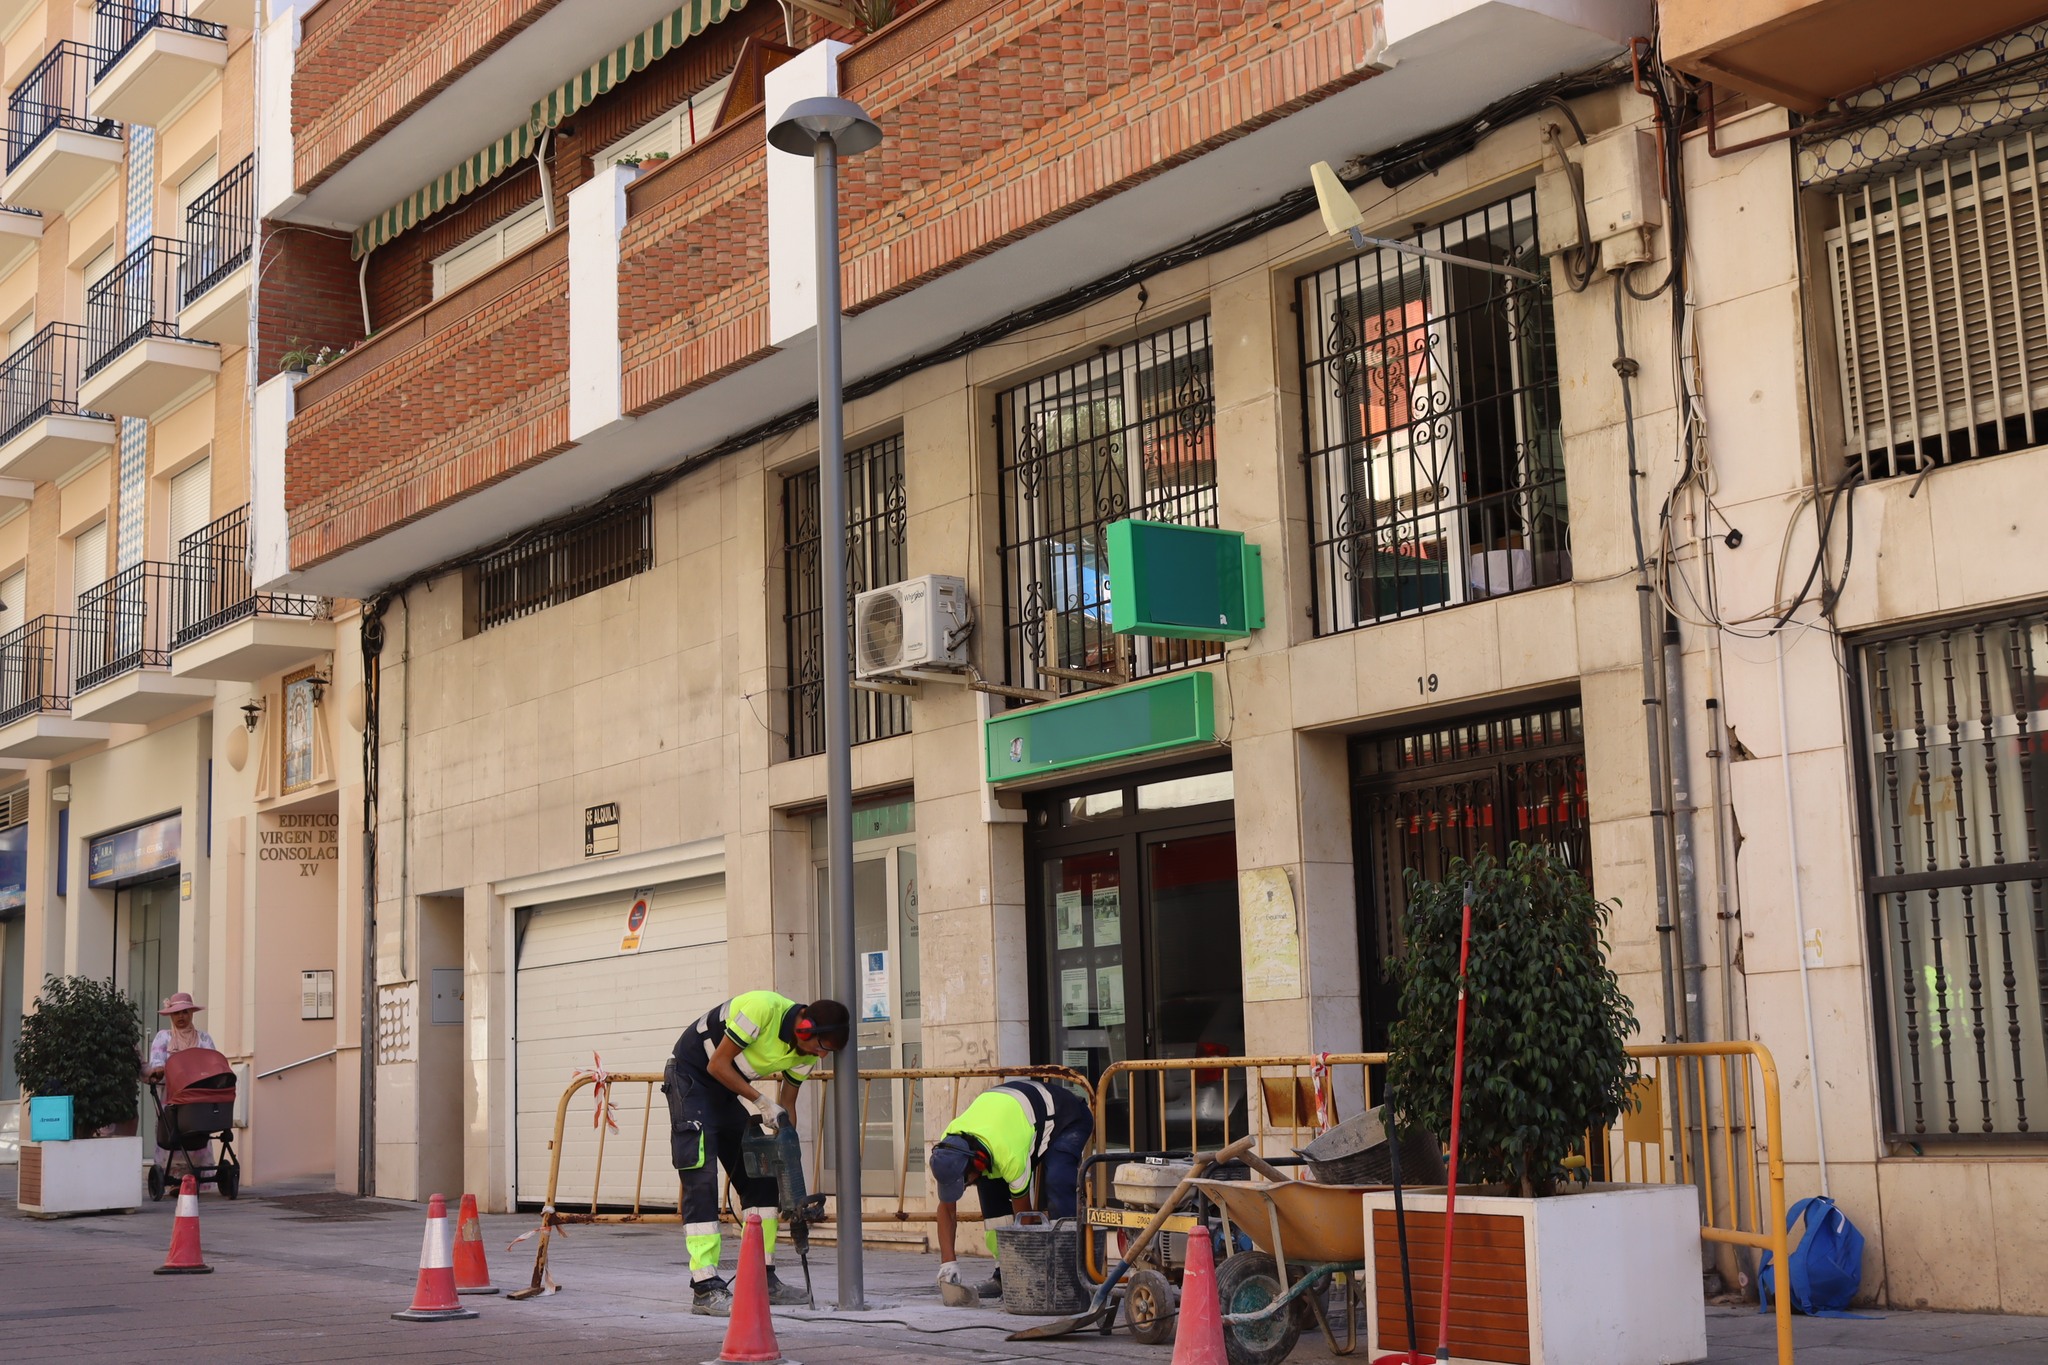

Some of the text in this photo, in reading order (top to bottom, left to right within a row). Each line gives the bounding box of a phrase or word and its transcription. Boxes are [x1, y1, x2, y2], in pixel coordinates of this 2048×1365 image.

[1418, 673, 1438, 695] 19
[279, 814, 339, 827] EDIFICIO
[586, 805, 618, 825] SE ALQUILA
[260, 830, 337, 844] VIRGEN DE
[300, 863, 318, 876] XV
[1090, 1211, 1122, 1224] AYERBE
